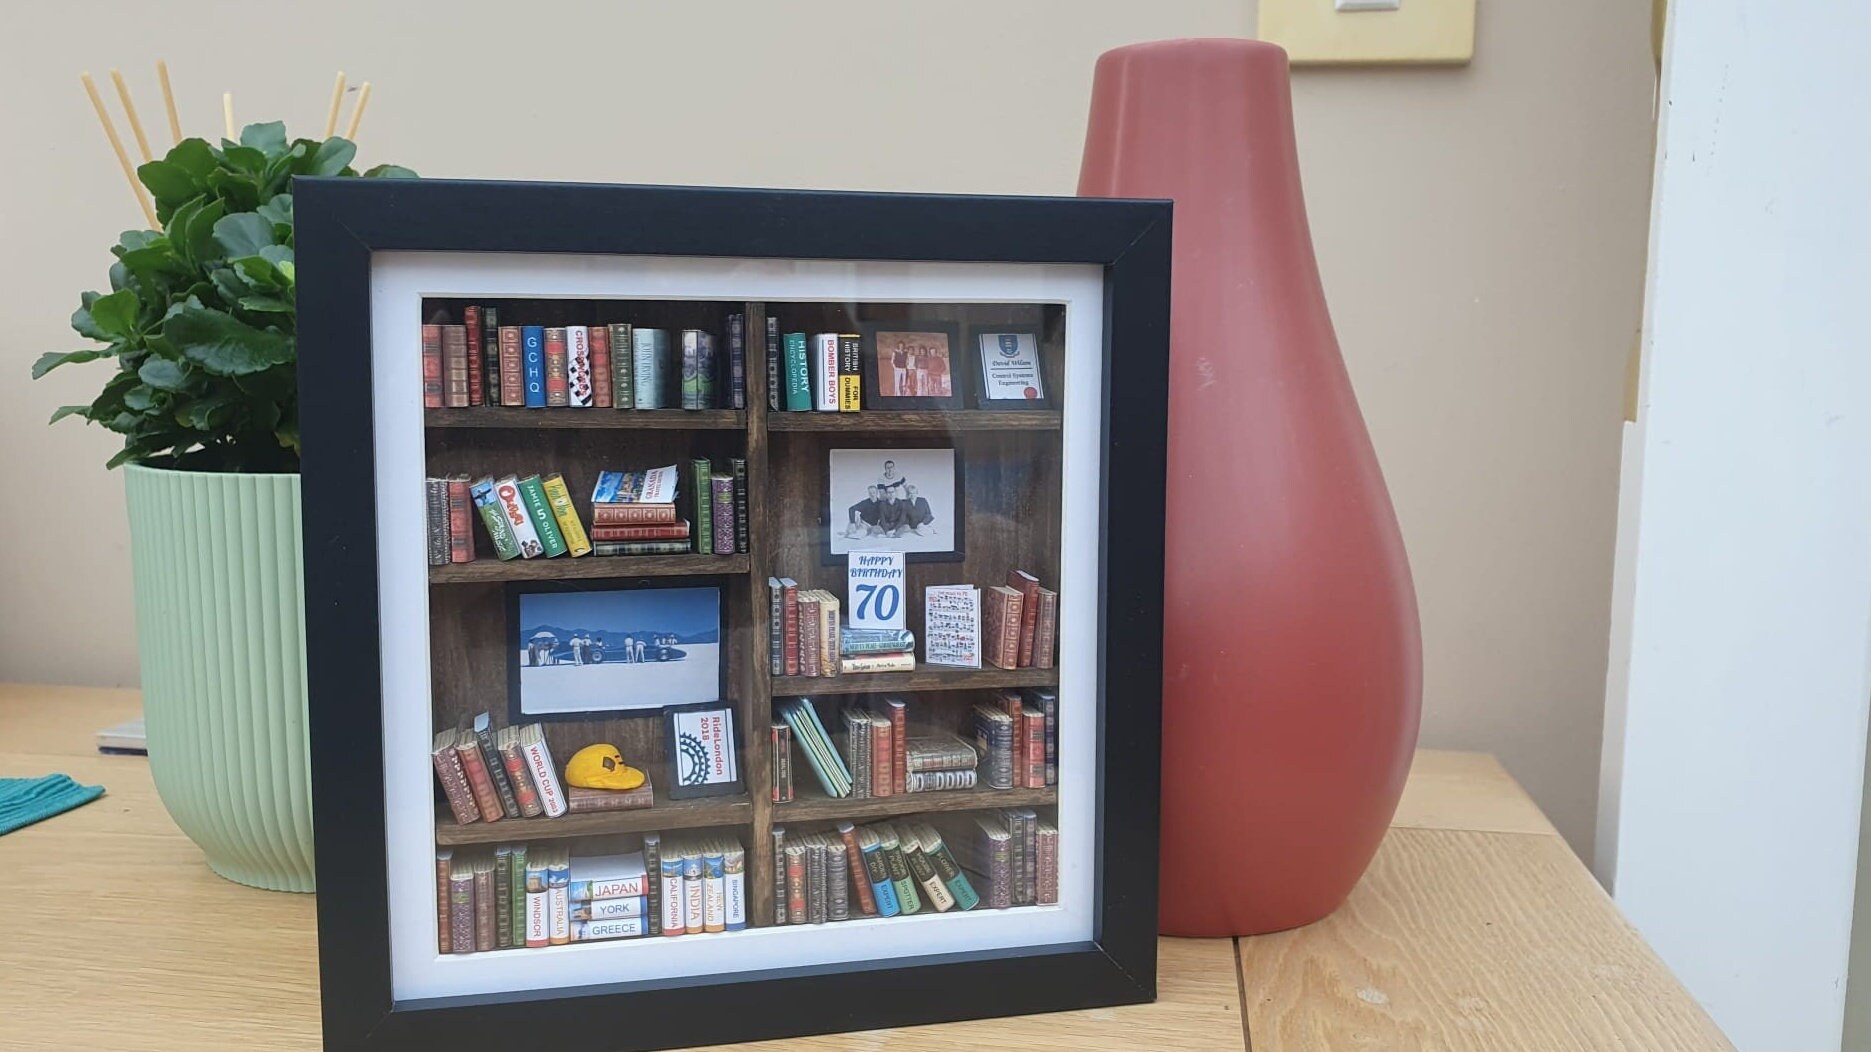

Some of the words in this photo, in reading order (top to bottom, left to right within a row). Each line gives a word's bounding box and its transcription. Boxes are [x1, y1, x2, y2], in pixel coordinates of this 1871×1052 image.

[527, 337, 540, 393] GCHQ
[798, 340, 810, 393] HISTORY
[827, 339, 835, 382] BOMBER
[828, 384, 836, 405] BOYS
[527, 484, 542, 508] JAMIE
[543, 522, 558, 549] OLIVER
[850, 568, 902, 578] BIRTHDAY
[858, 556, 894, 566] HAPPY
[855, 584, 900, 621] 70
[700, 716, 710, 741] 2018
[712, 716, 723, 776] RideLondon
[530, 746, 546, 778] WORLD
[542, 779, 554, 796] CUP
[594, 882, 638, 897] JAPAN
[600, 902, 630, 914] YORK
[670, 878, 679, 928] CALIFORNIA
[690, 886, 701, 921] INDIA
[706, 884, 714, 922] ZEALAND
[732, 879, 740, 919] SINGAPORE
[881, 884, 894, 909] EXPERT
[900, 880, 915, 910] SPOTTER
[929, 881, 947, 904] EXPERT
[533, 896, 542, 938] WINDSOR
[555, 888, 564, 935] AUSTRALIA
[592, 922, 636, 935] GREECE
